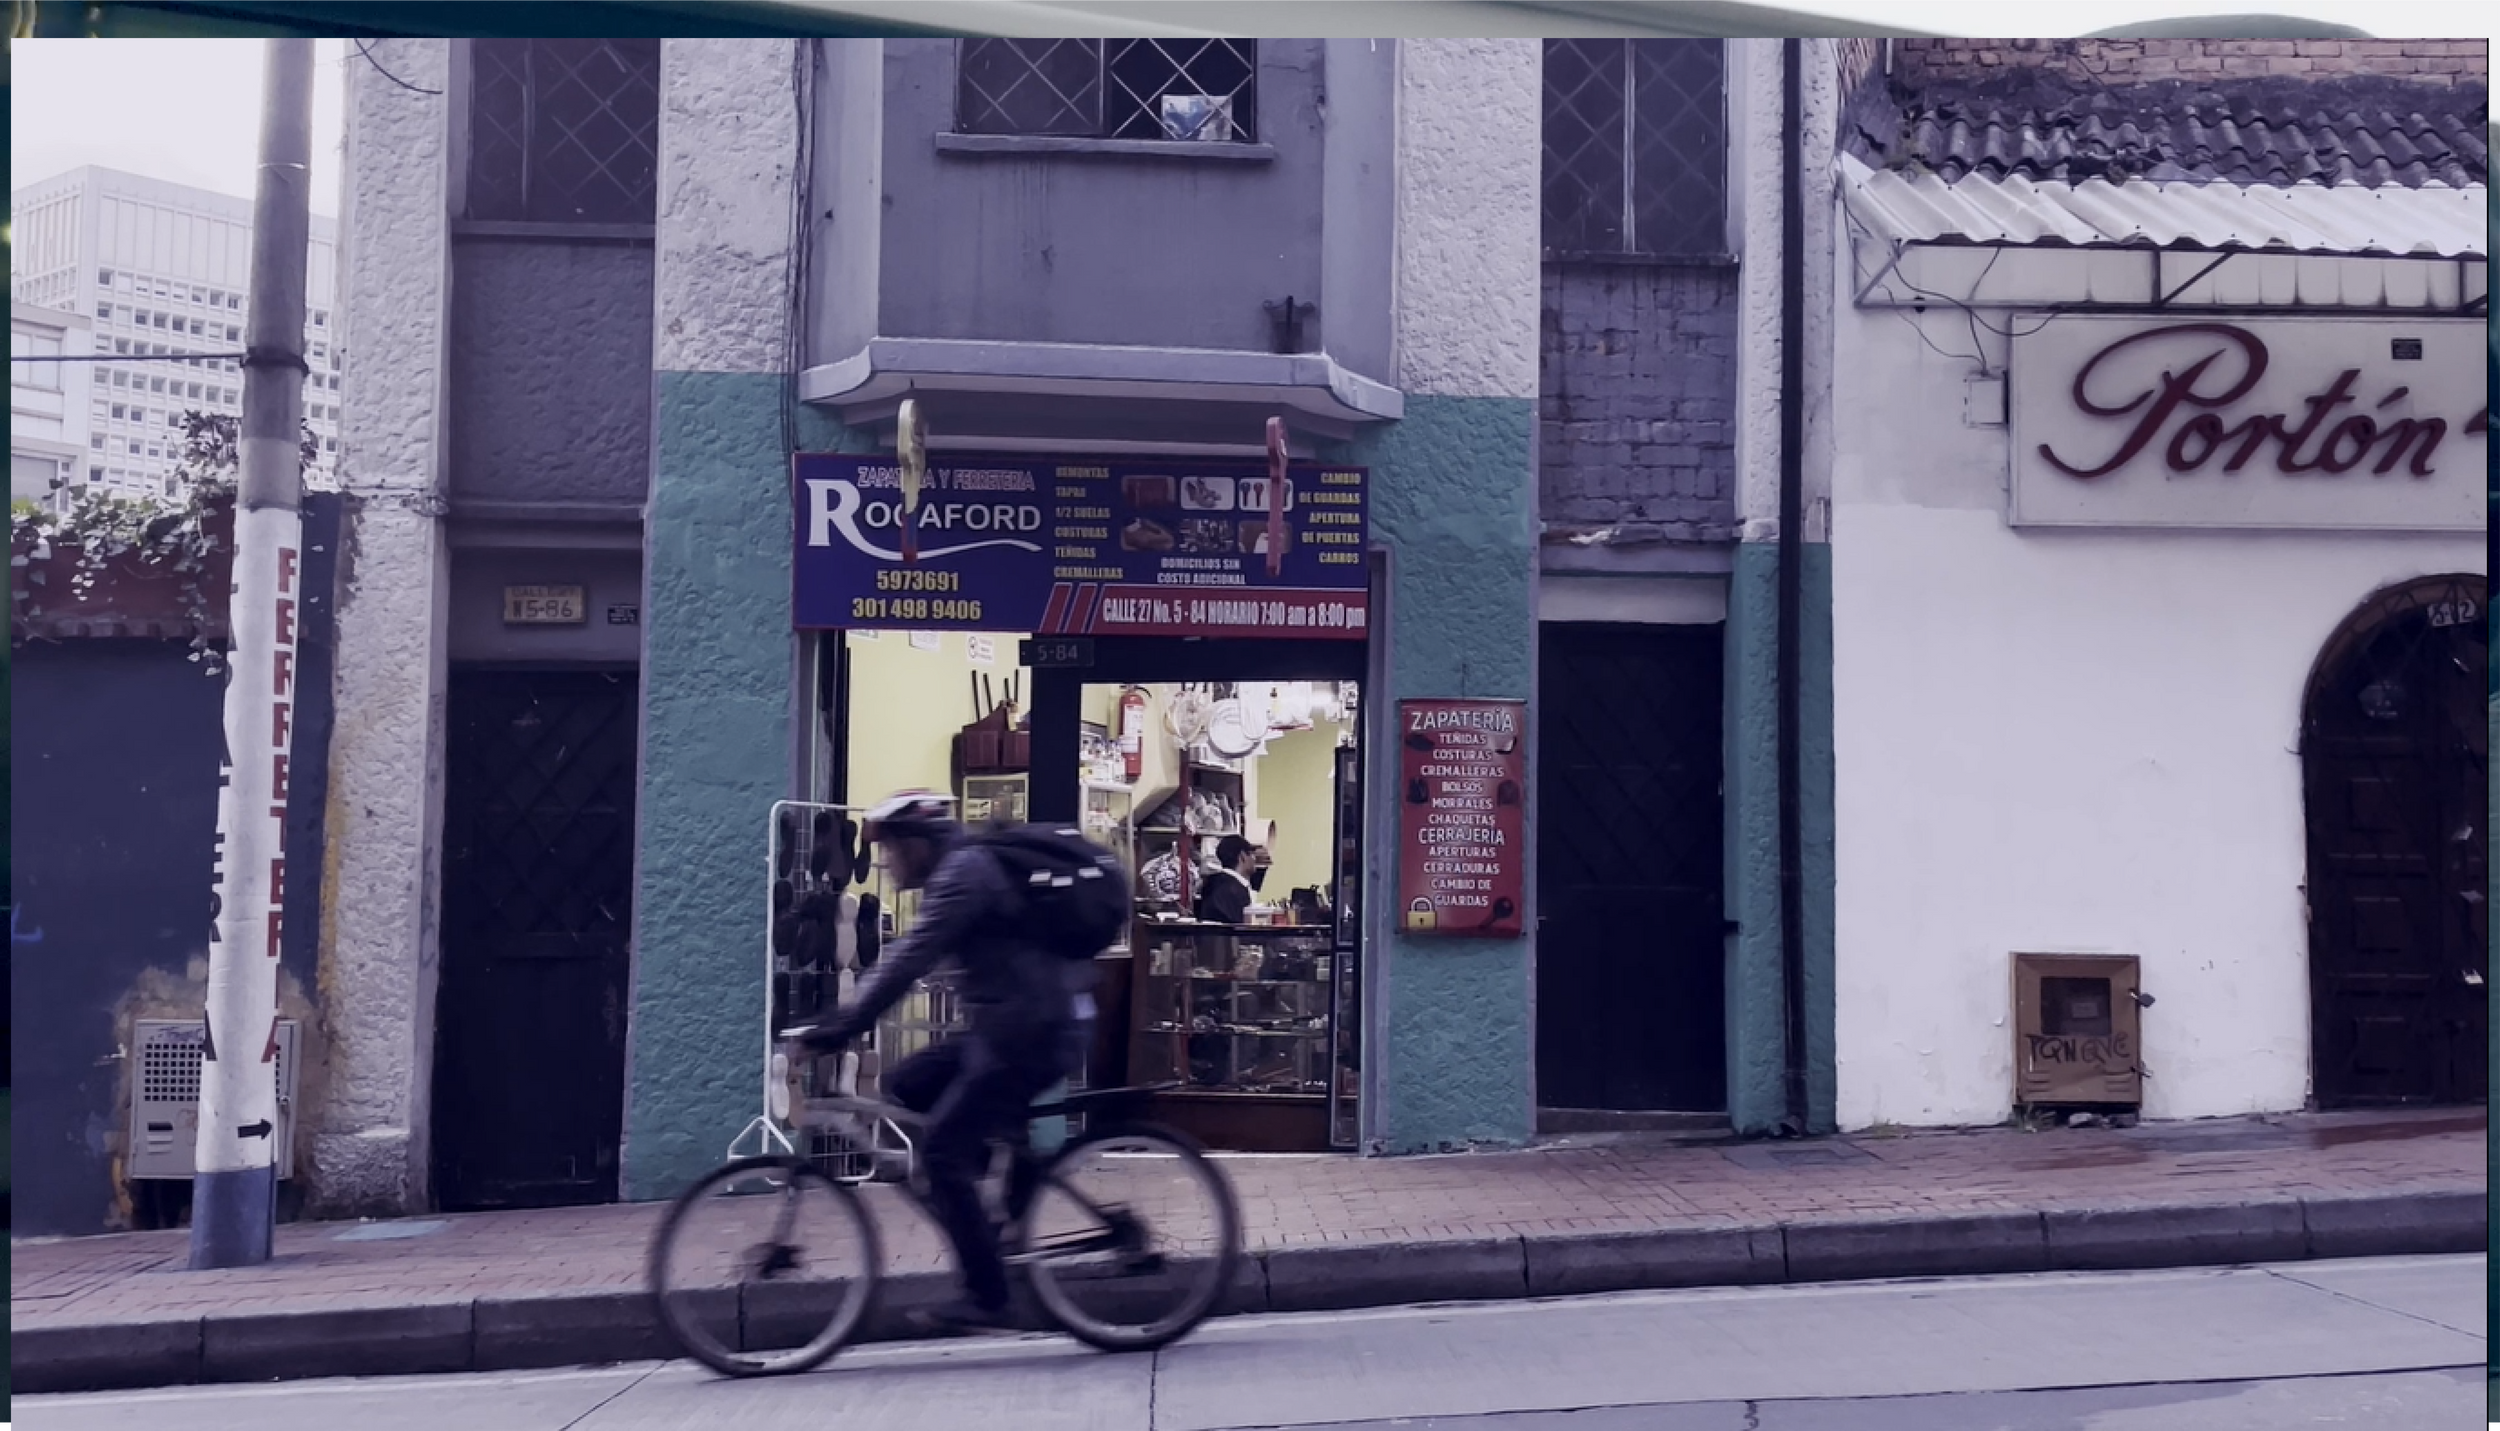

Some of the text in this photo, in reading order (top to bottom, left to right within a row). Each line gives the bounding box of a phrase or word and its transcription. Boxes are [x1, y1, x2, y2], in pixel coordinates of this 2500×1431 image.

[2038, 323, 2447, 478] Portón
[938, 468, 950, 489] Y
[1055, 506, 1072, 518] 1/2
[1161, 557, 1221, 570] DOMICILIOS
[876, 570, 960, 591] 5973691
[1157, 572, 1246, 585] COSTO ADICIONAL
[852, 598, 982, 620] 301 498 9406
[1103, 598, 1137, 622] CALLE
[1138, 598, 1152, 622] 27
[1173, 599, 1182, 623] 5
[1190, 600, 1205, 624] 84
[1207, 600, 1260, 625] HORARIO
[1261, 601, 1285, 625] 7:00
[1287, 605, 1307, 626] am
[1308, 606, 1316, 627] a
[1318, 602, 1345, 627] 8:00
[1346, 607, 1366, 630] pm
[1037, 643, 1079, 662] 5-84
[1439, 731, 1487, 744] TEÑIDAS
[1432, 749, 1492, 761] COSTURAS
[1420, 765, 1504, 777] CREMALLERAS
[1441, 781, 1484, 793] BOLSOS
[1432, 798, 1493, 810] MORRALES
[1428, 814, 1496, 827] CHAQUETAS
[1428, 846, 1497, 858] APERTURAS
[1423, 862, 1500, 875] CERRADURAS
[1430, 879, 1492, 890] CAMBIO DE
[1434, 895, 1489, 907] GUARDAS
